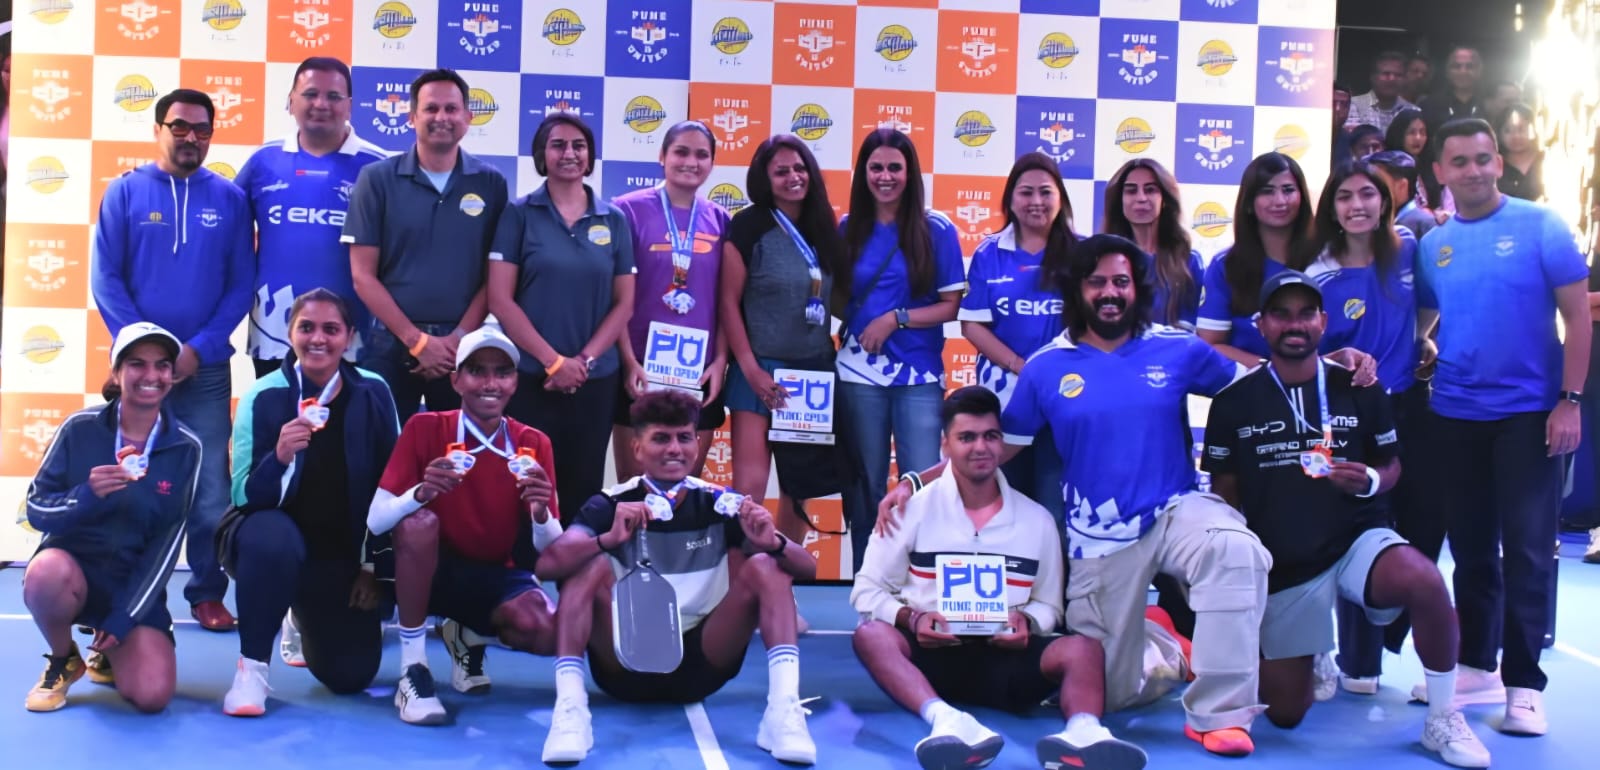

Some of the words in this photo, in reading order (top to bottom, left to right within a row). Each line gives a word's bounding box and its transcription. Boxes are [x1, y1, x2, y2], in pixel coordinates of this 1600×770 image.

[464, 3, 499, 13] PUNE
[632, 11, 667, 21] PUNE
[799, 19, 834, 29] PUNE
[962, 26, 998, 36] PUNE
[1123, 34, 1157, 44] PUNE
[459, 37, 500, 56] UNITED
[627, 44, 668, 63] UNITED
[546, 90, 581, 100] PUNE
[714, 98, 749, 108] PUNE
[1040, 112, 1074, 122] PUNE
[1199, 119, 1233, 129] PUNE
[942, 563, 1003, 598] PU
